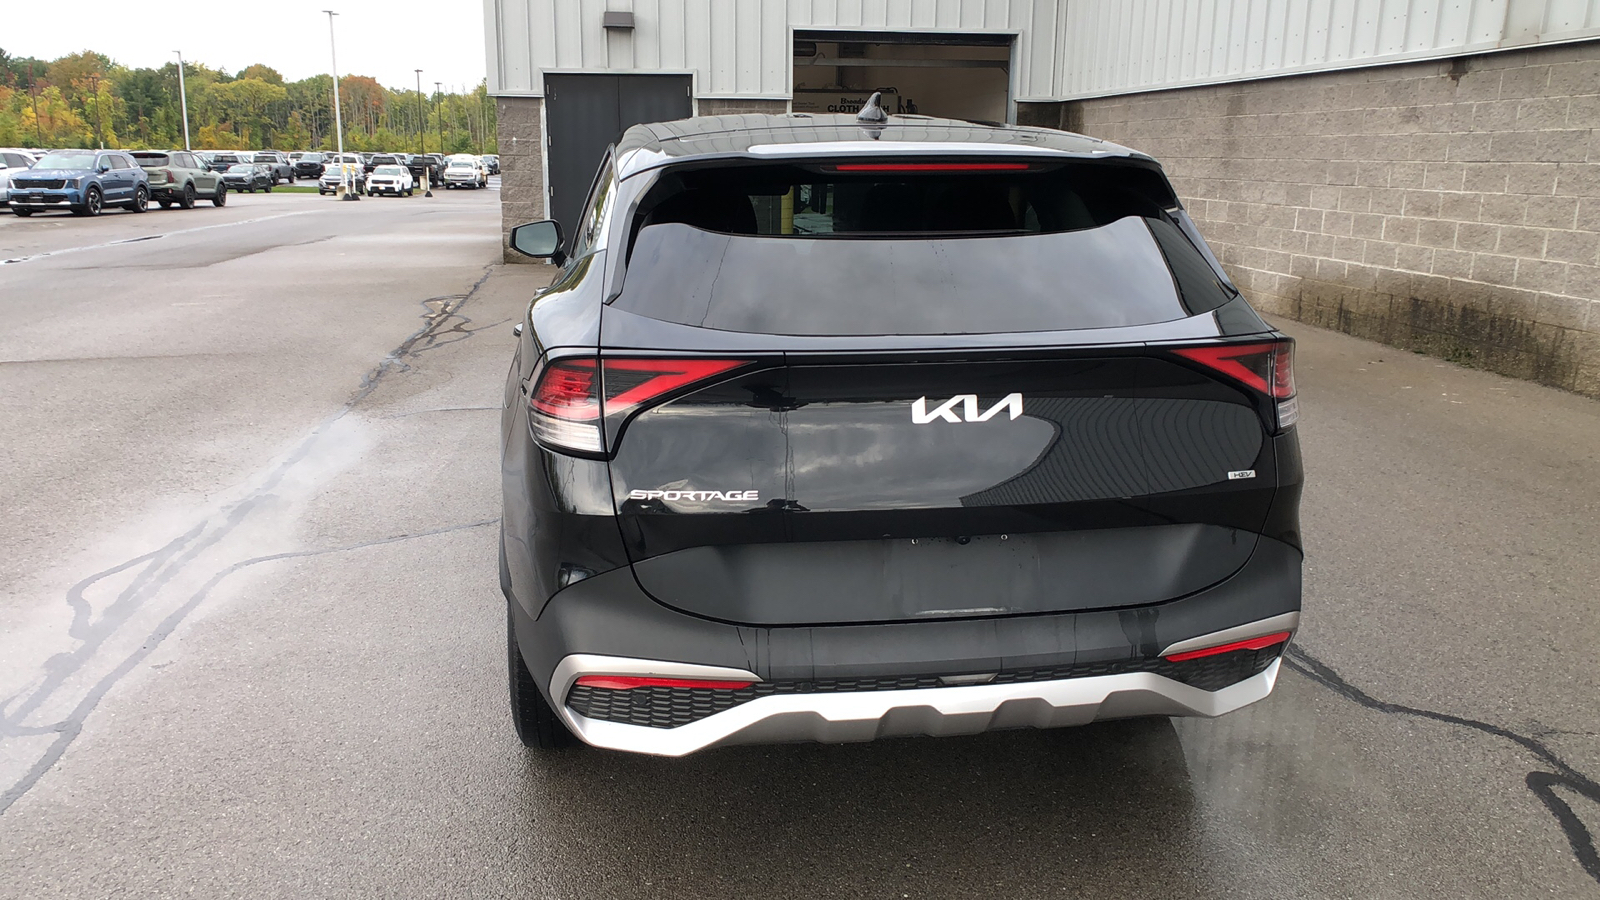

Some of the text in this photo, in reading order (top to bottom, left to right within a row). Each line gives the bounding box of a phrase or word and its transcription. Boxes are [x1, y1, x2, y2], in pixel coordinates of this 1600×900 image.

[827, 105, 859, 113] CLOTH
[911, 392, 1023, 424] KIA
[630, 489, 759, 501] SPORTAGE
